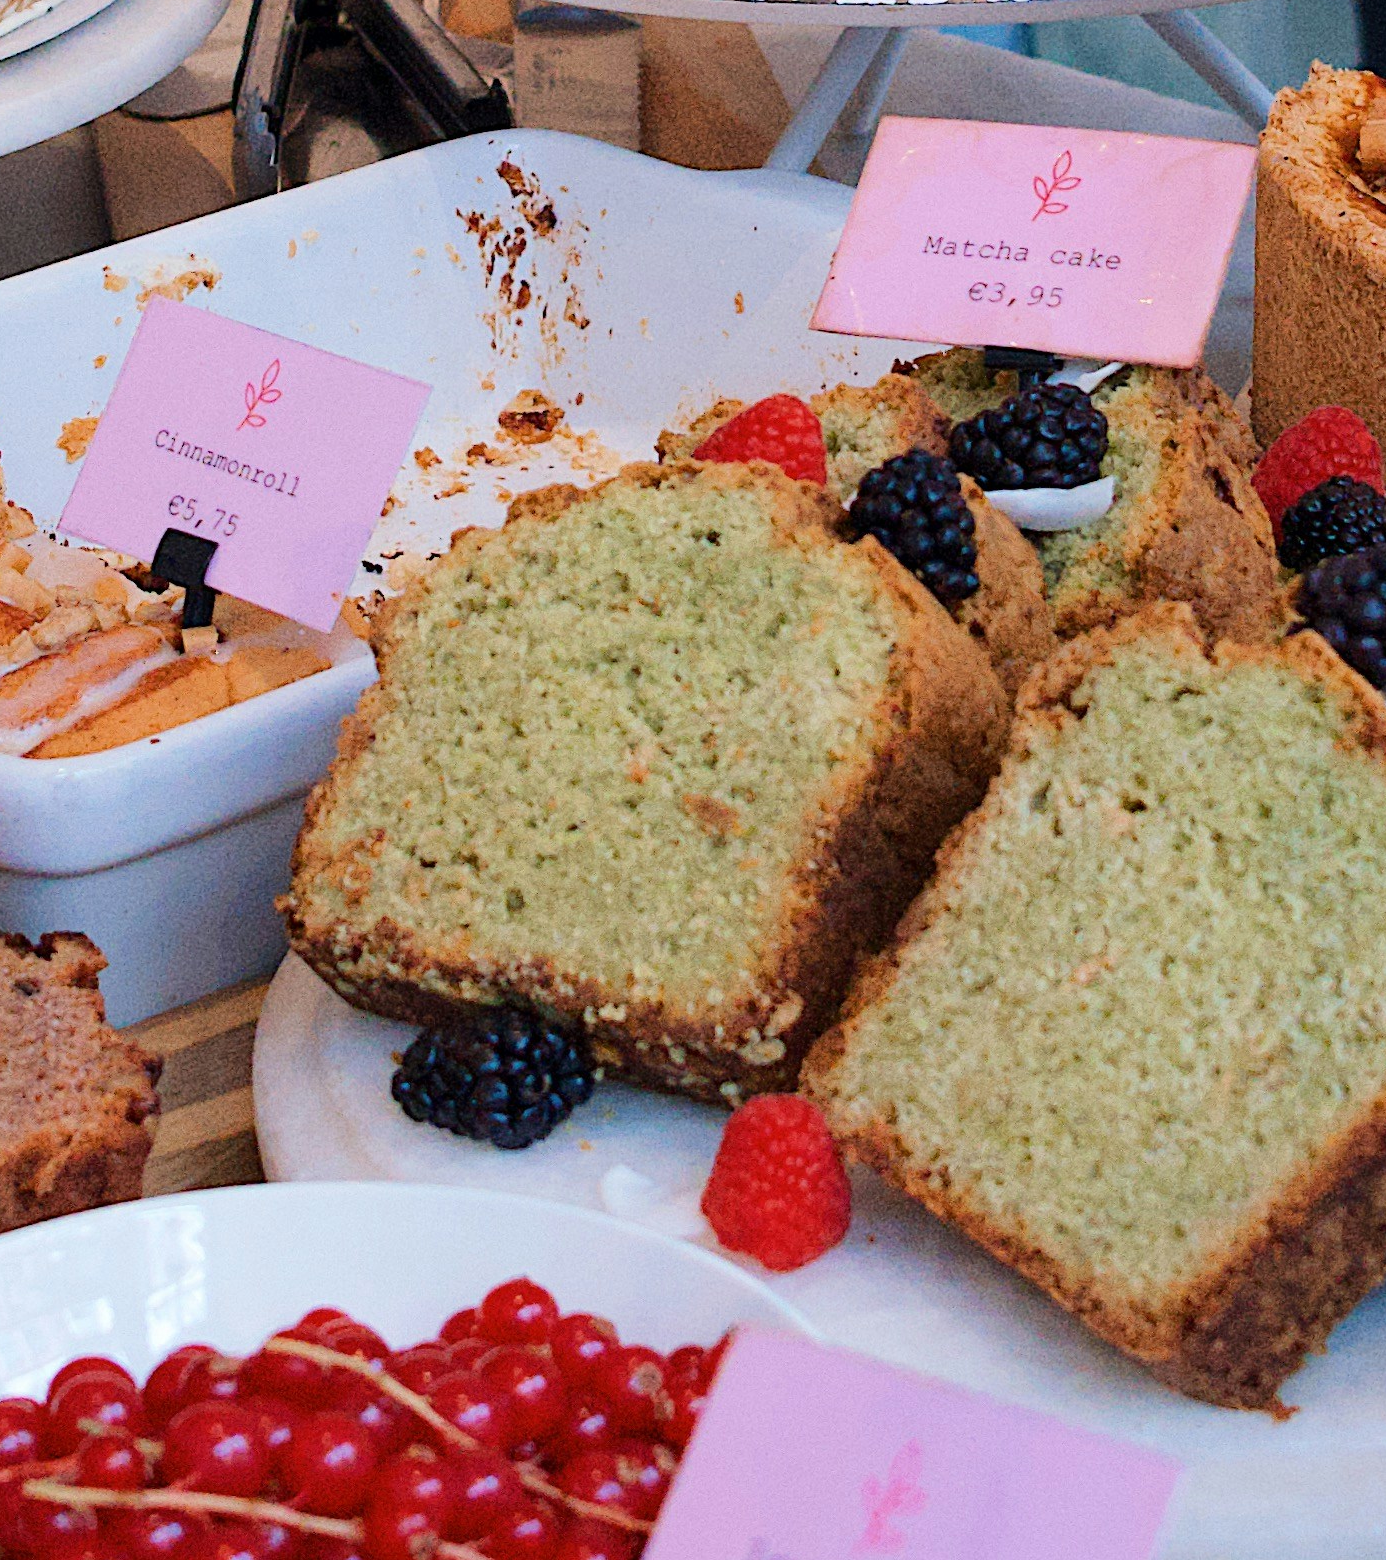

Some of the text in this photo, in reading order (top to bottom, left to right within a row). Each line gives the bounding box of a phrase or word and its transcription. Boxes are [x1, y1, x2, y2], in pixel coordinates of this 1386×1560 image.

[922, 235, 1122, 271] Matcha cake
[968, 281, 1064, 308] €3,95
[154, 429, 303, 498] Cinnamonroll
[168, 495, 241, 537] €5,75
